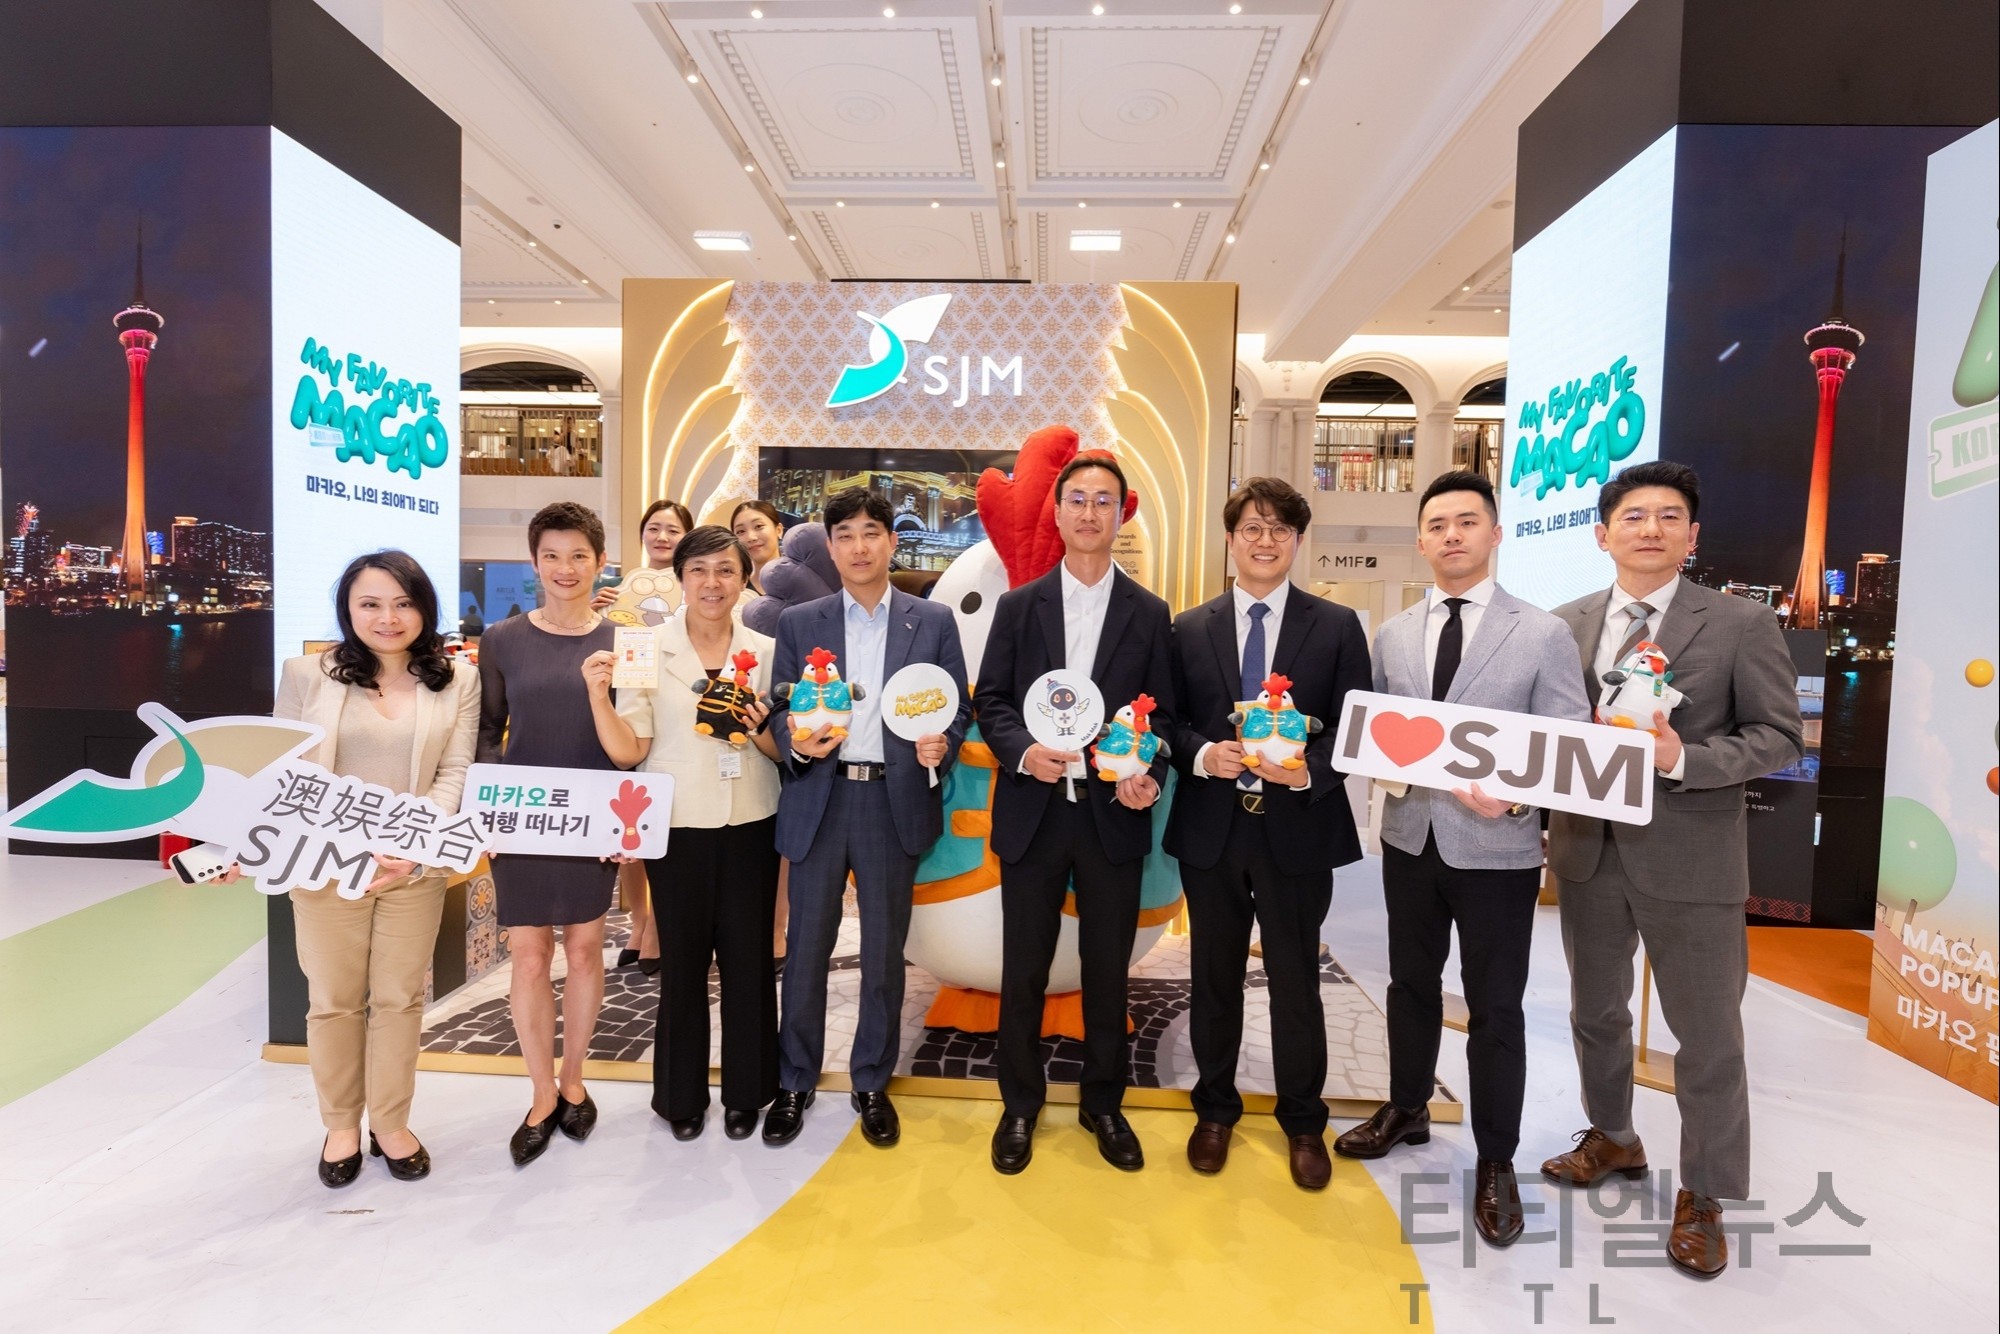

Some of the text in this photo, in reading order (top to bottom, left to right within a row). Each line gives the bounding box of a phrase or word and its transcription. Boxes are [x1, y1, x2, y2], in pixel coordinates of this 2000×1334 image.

[301, 337, 440, 416] MY FAVORITE
[923, 355, 1023, 408] SJM
[1519, 355, 1637, 433] MY FAVORITE
[291, 375, 449, 480] MACAO
[1510, 391, 1645, 501] MACAO
[306, 475, 439, 515] 마카오, 나의 최애가 되다
[1516, 518, 1545, 538] 마카오,
[1547, 512, 1566, 532] 나의
[1335, 556, 1364, 567] M1F
[895, 693, 947, 719] MACAO
[1342, 704, 1645, 808] I SJM
[262, 768, 485, 865] 澳娱综合
[478, 784, 569, 808] 마카오로
[479, 810, 590, 837] 여행 떠나기
[235, 823, 375, 891] SJM
[1902, 923, 1999, 978] MACA
[1896, 994, 1978, 1053] 마카오
